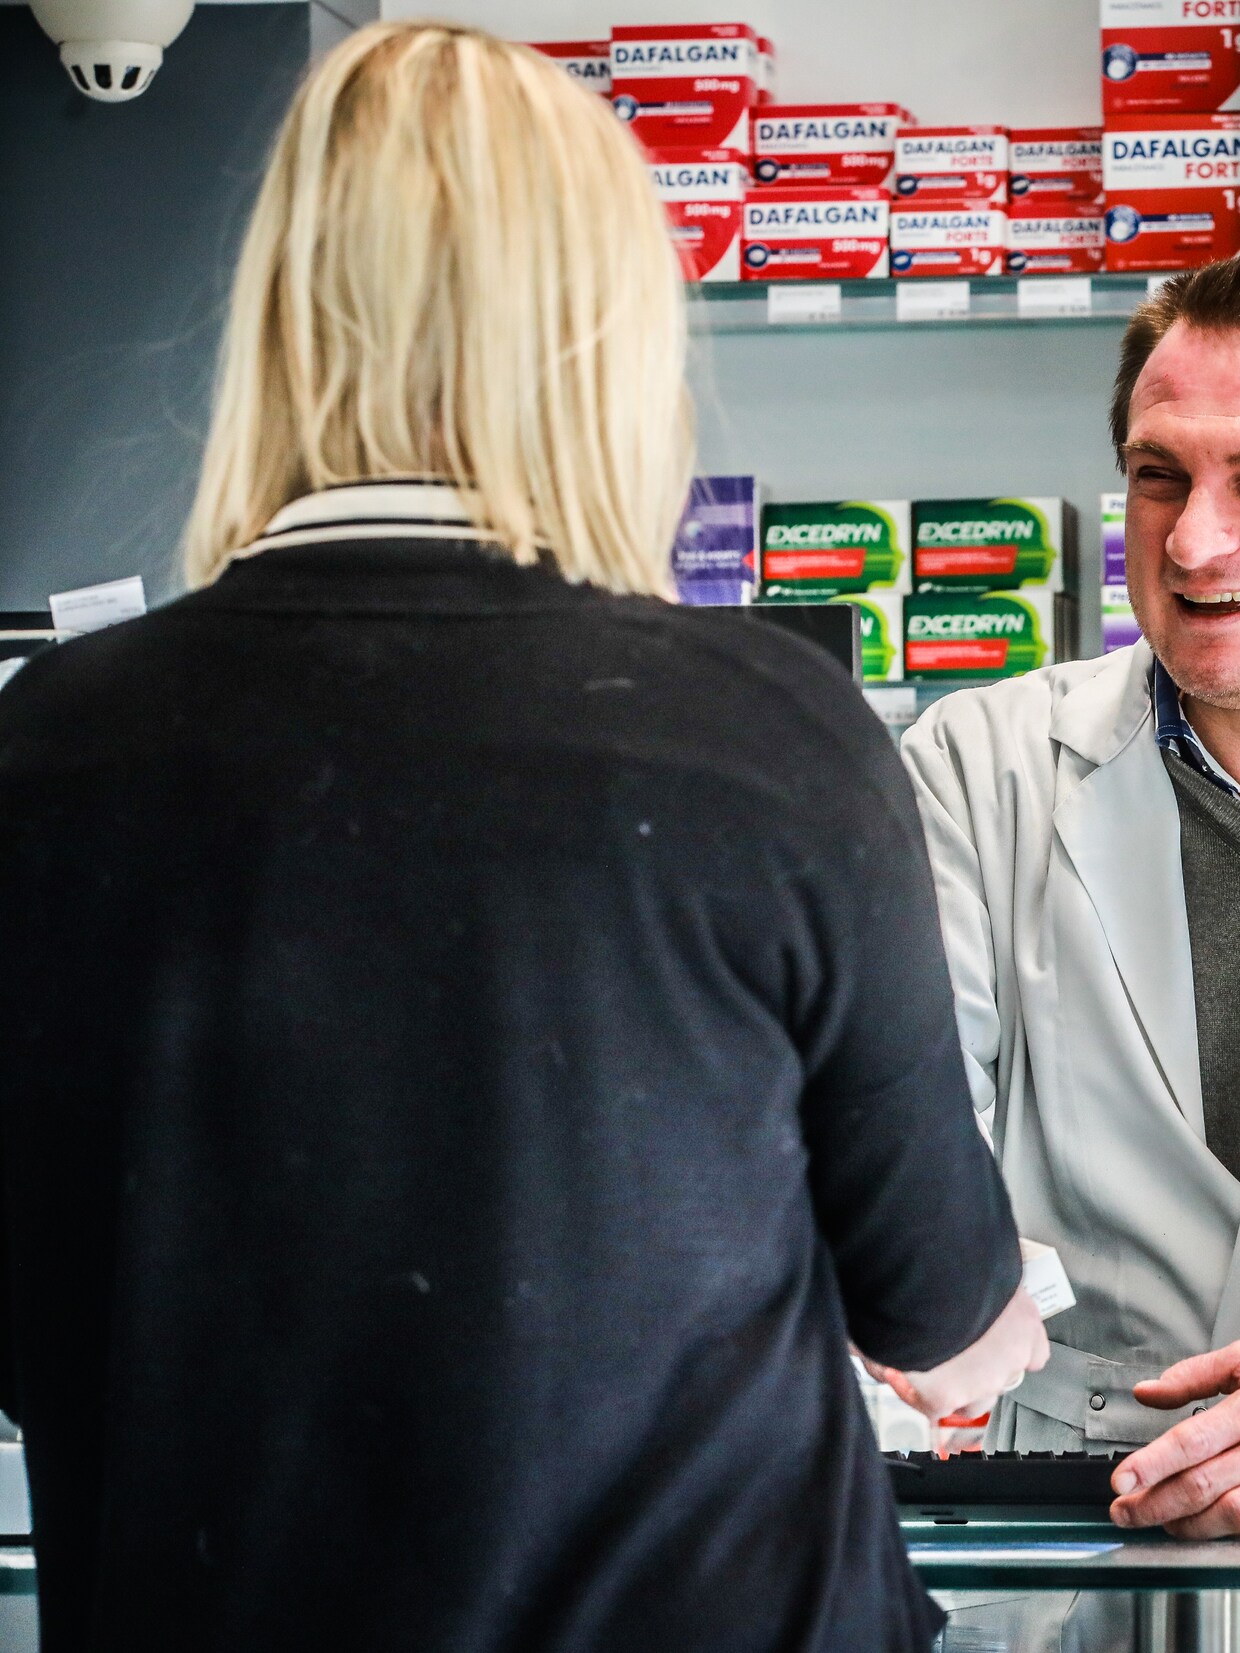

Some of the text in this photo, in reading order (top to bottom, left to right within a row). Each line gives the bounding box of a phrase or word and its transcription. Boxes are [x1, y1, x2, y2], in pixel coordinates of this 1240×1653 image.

[615, 45, 738, 63] DAFALGAN
[760, 121, 887, 140] DAFALGAN
[903, 141, 994, 154] DAFALGAN
[1014, 143, 1102, 156] DAFALGAN
[951, 156, 993, 166] FORTE
[749, 206, 878, 225] DAFALGAN
[897, 217, 989, 230] DAFALGAN
[1013, 221, 1099, 233] DAFALGAN
[946, 232, 988, 242] FORTE
[767, 523, 883, 545] EXCEDRYN
[917, 520, 1035, 541] EXCEDRYN
[907, 613, 1025, 635] EXCEDRYN
